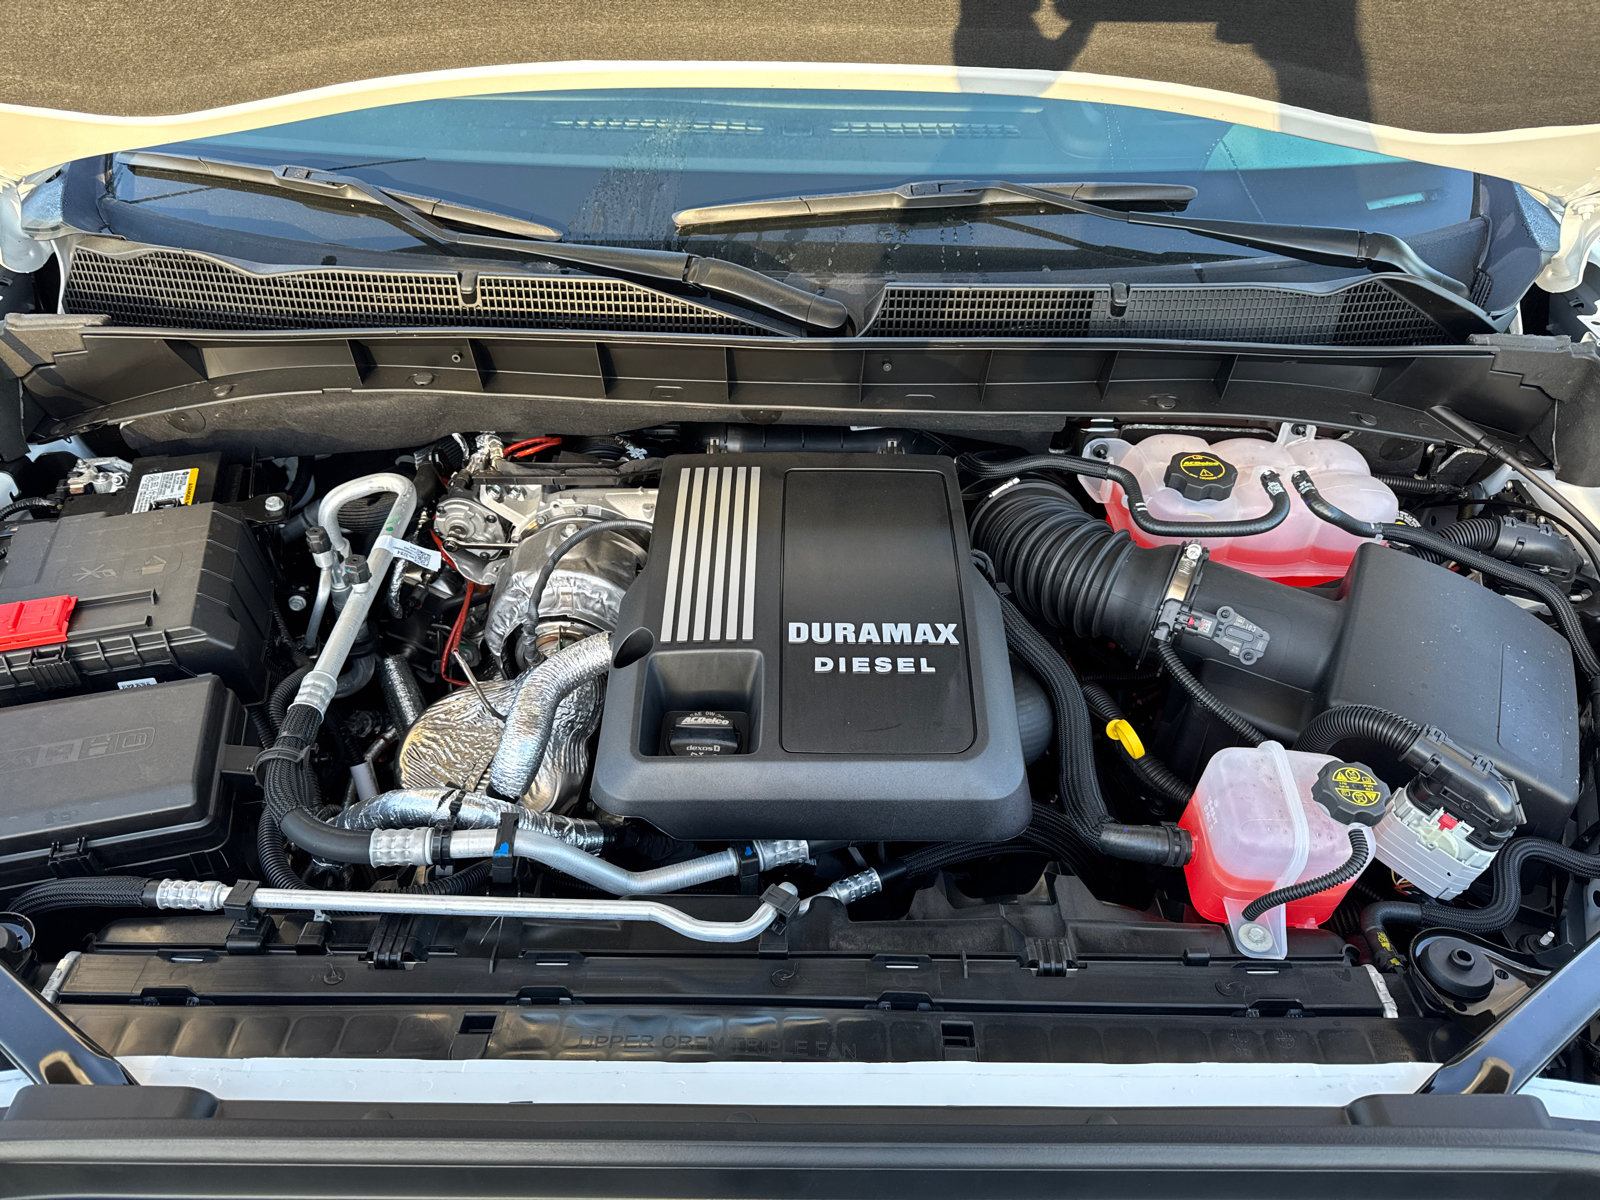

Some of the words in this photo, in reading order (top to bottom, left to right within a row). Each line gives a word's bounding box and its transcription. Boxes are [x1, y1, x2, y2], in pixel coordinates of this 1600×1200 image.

[788, 622, 960, 645] DURAMAX
[814, 657, 936, 674] DIESEL
[681, 716, 730, 725] ACDelco
[577, 1034, 655, 1049] UPPER
[731, 1036, 808, 1056] TRIPLE
[815, 1040, 858, 1060] FAN
